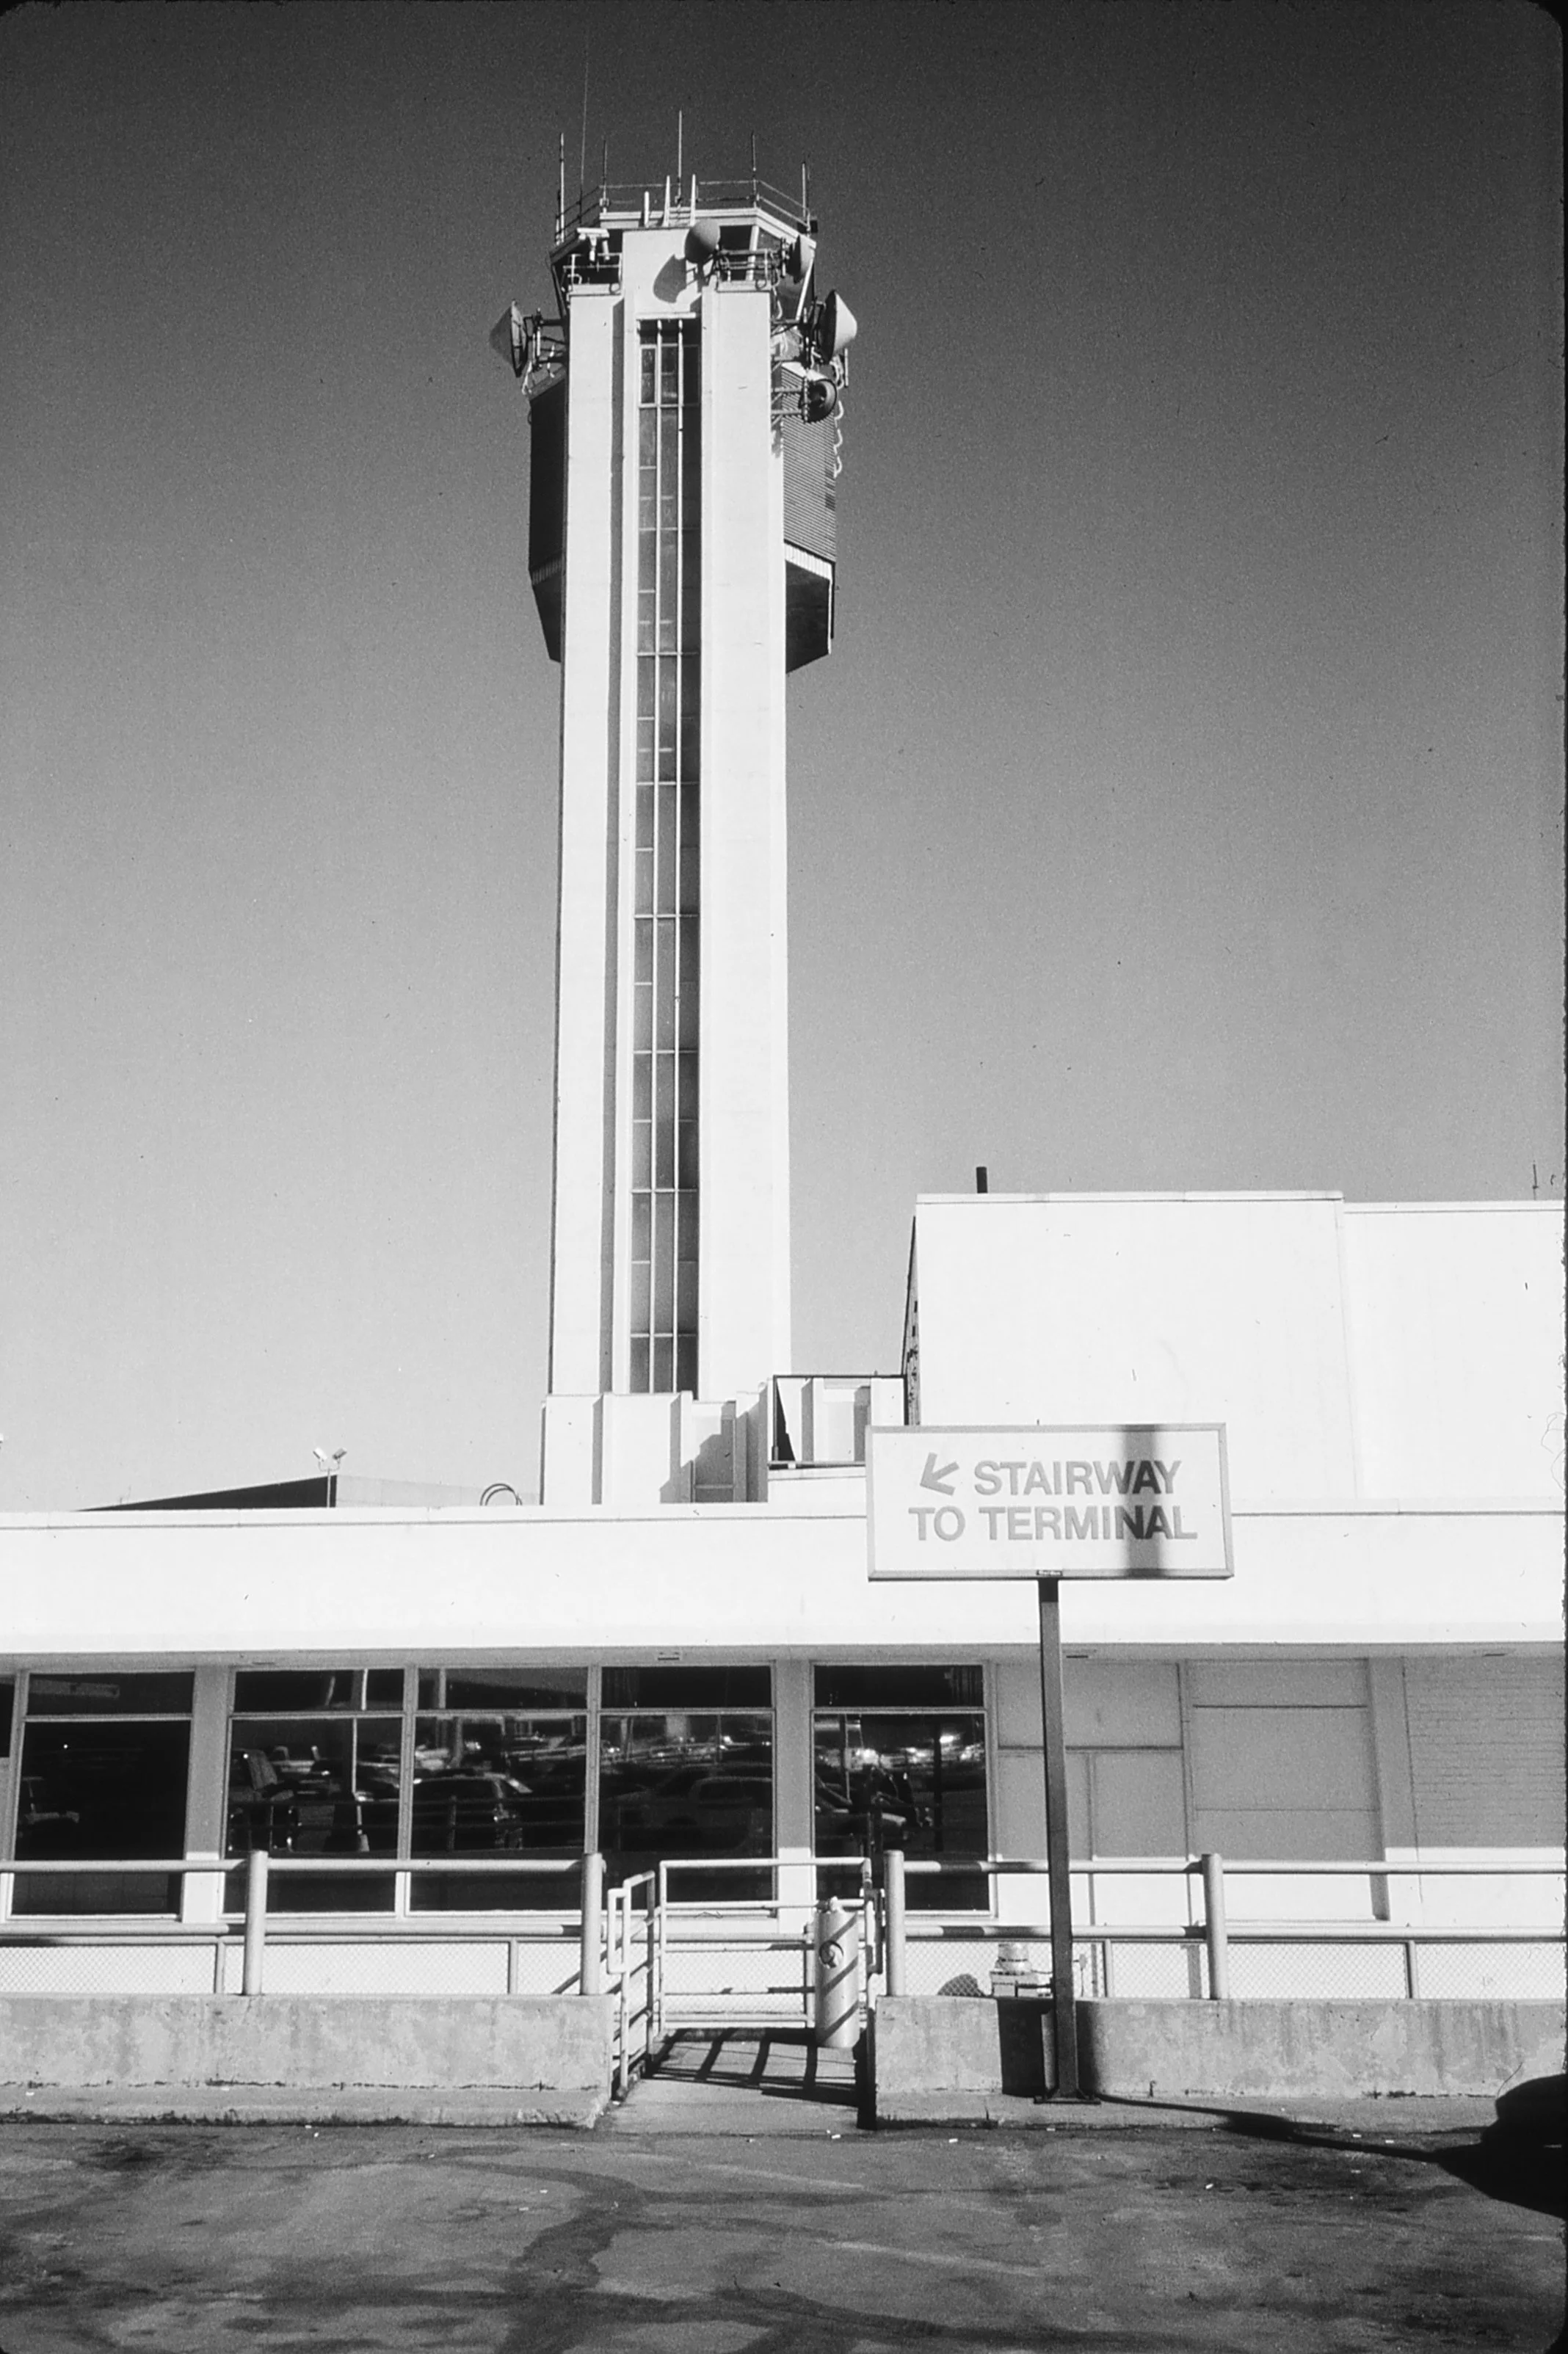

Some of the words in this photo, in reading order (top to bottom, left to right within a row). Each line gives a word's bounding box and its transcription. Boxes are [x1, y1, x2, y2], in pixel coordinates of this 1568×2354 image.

[974, 1460, 1182, 1496] STAIRWAY
[908, 1505, 966, 1541] TO
[979, 1505, 1199, 1540] TERMINAL
